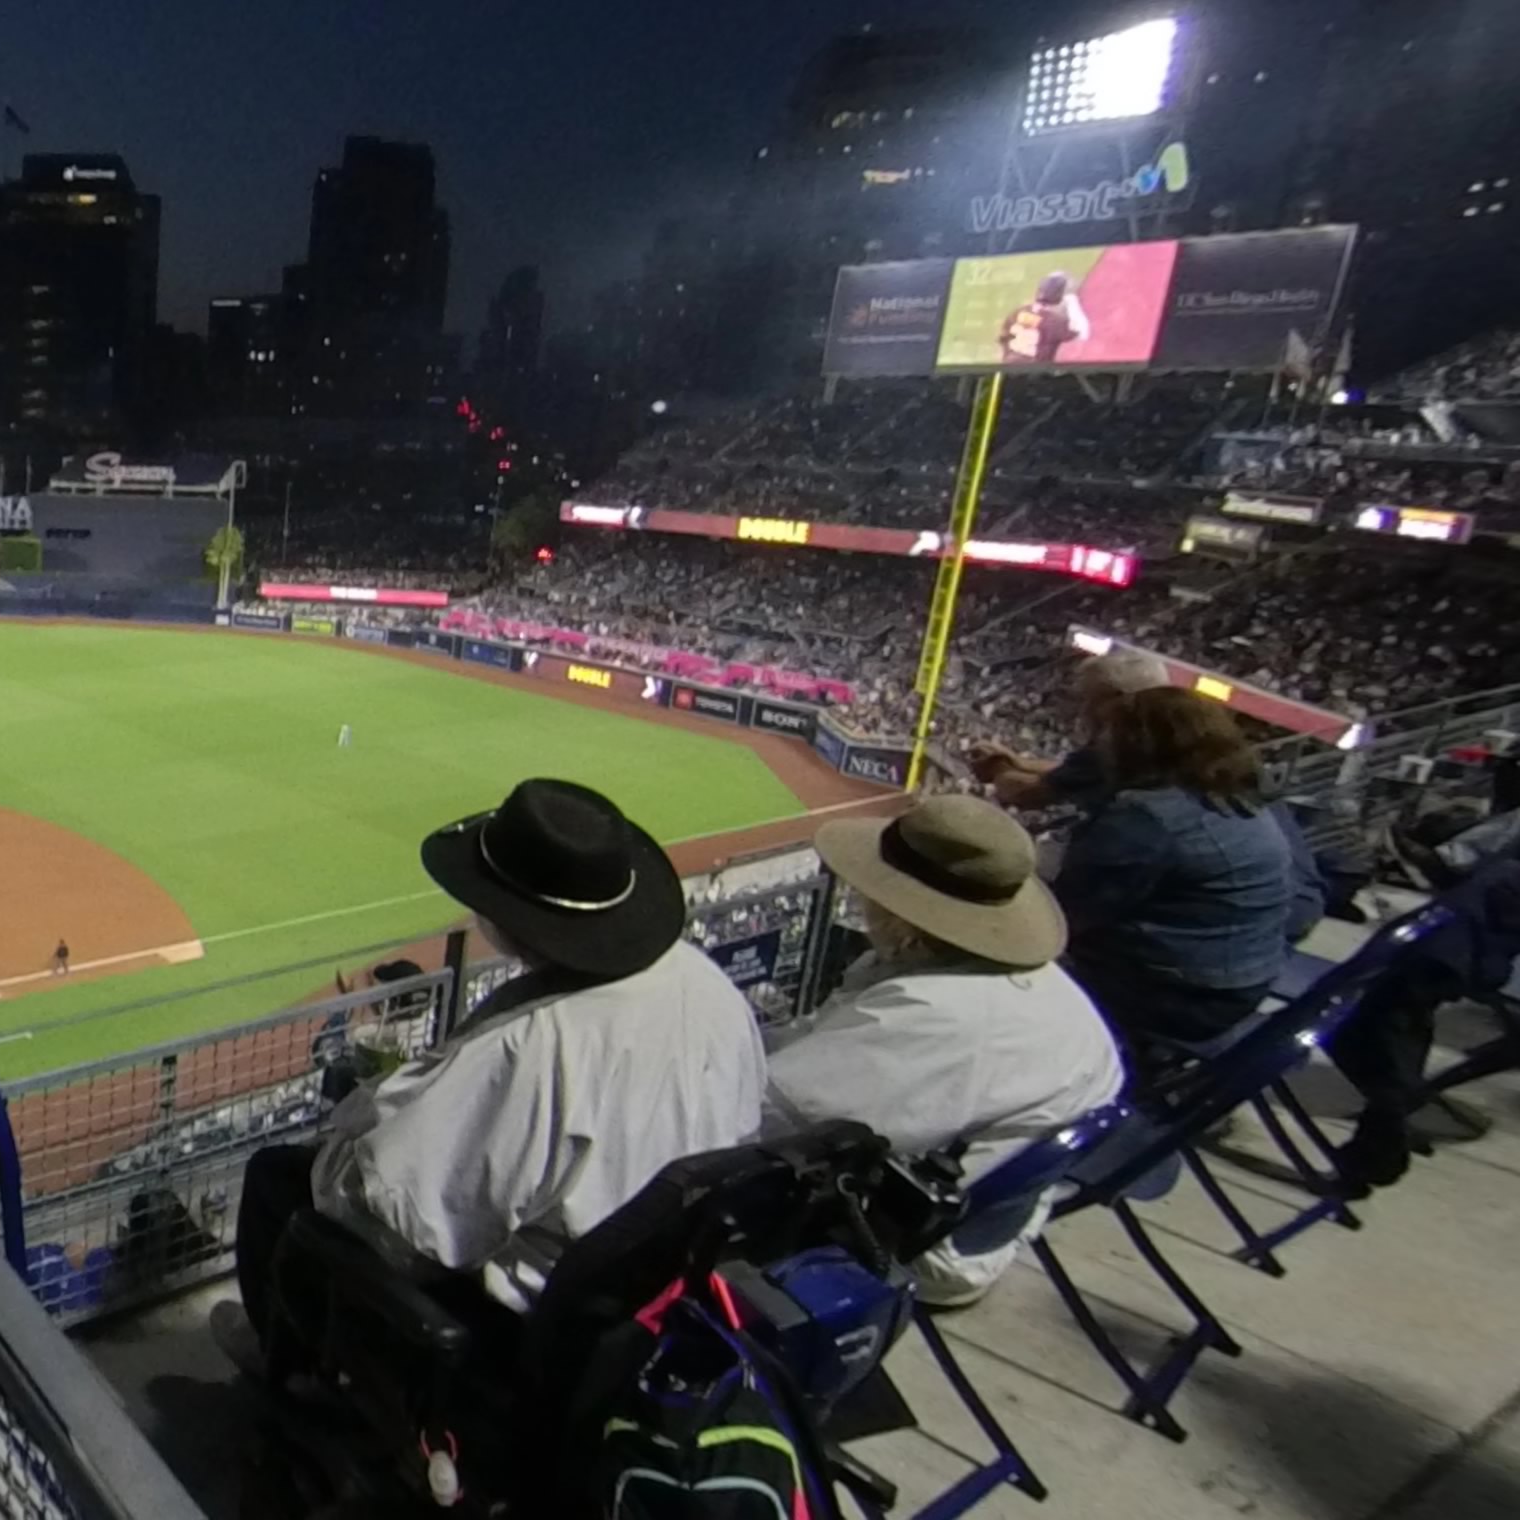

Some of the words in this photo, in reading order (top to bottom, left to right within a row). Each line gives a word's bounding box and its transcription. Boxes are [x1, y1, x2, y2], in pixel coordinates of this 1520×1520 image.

[971, 180, 1115, 233] Viasat
[737, 516, 810, 544] DOUBLE
[568, 664, 611, 688] DOUBLE
[848, 755, 898, 783] NECA
